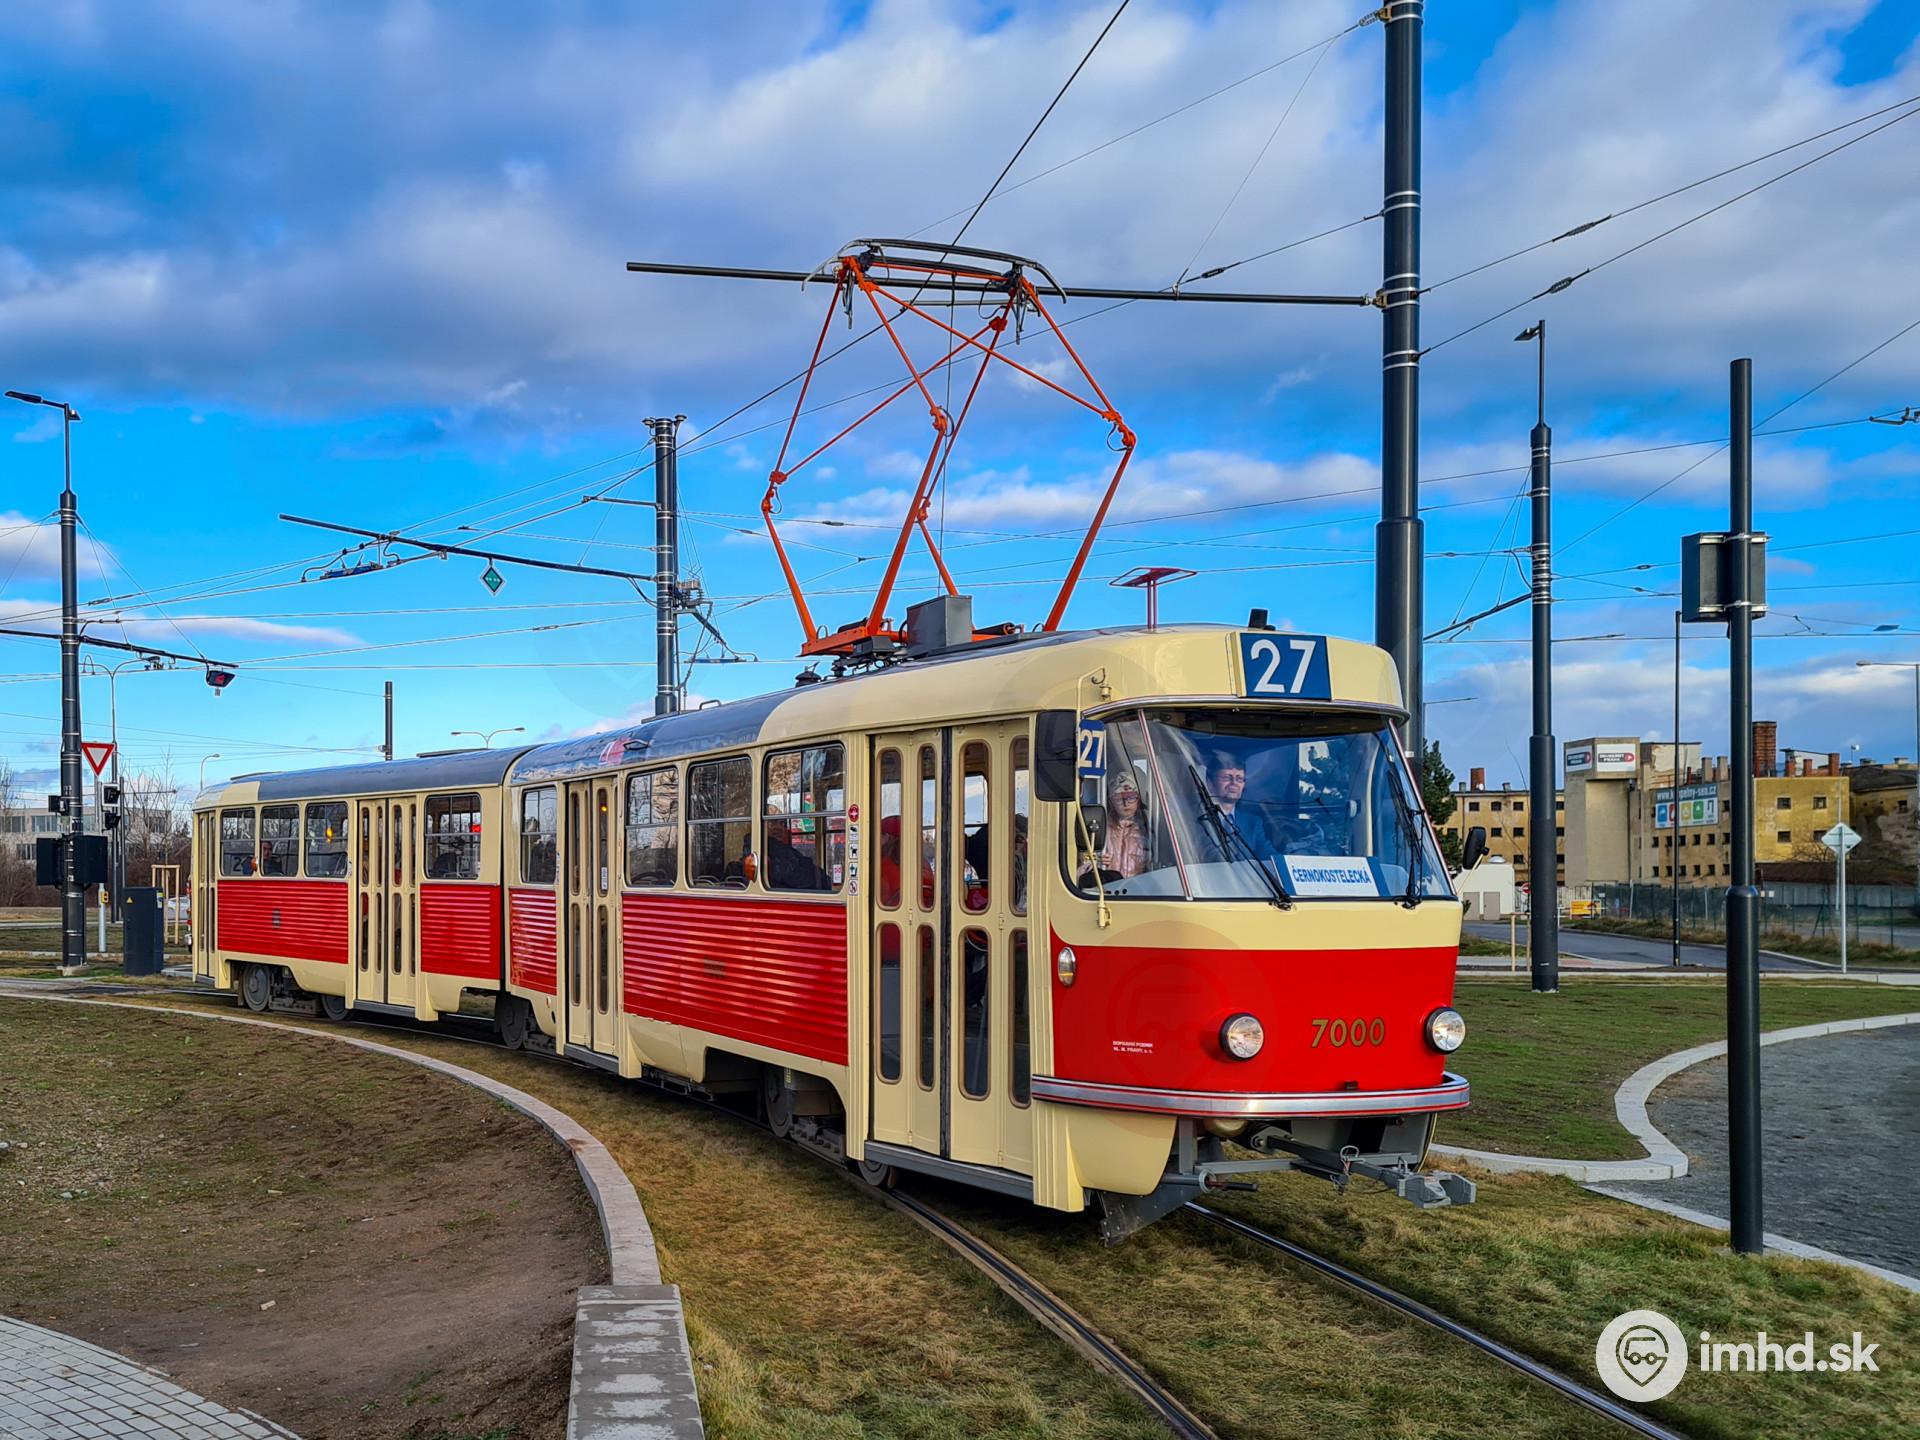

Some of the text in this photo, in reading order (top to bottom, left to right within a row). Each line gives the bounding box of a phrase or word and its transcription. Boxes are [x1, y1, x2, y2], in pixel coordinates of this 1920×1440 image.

[1250, 638, 1317, 694] 27
[1077, 729, 1104, 768] 27
[1292, 864, 1372, 884] ČERNOKOSTELECKÁ
[1311, 1017, 1385, 1048] 7000
